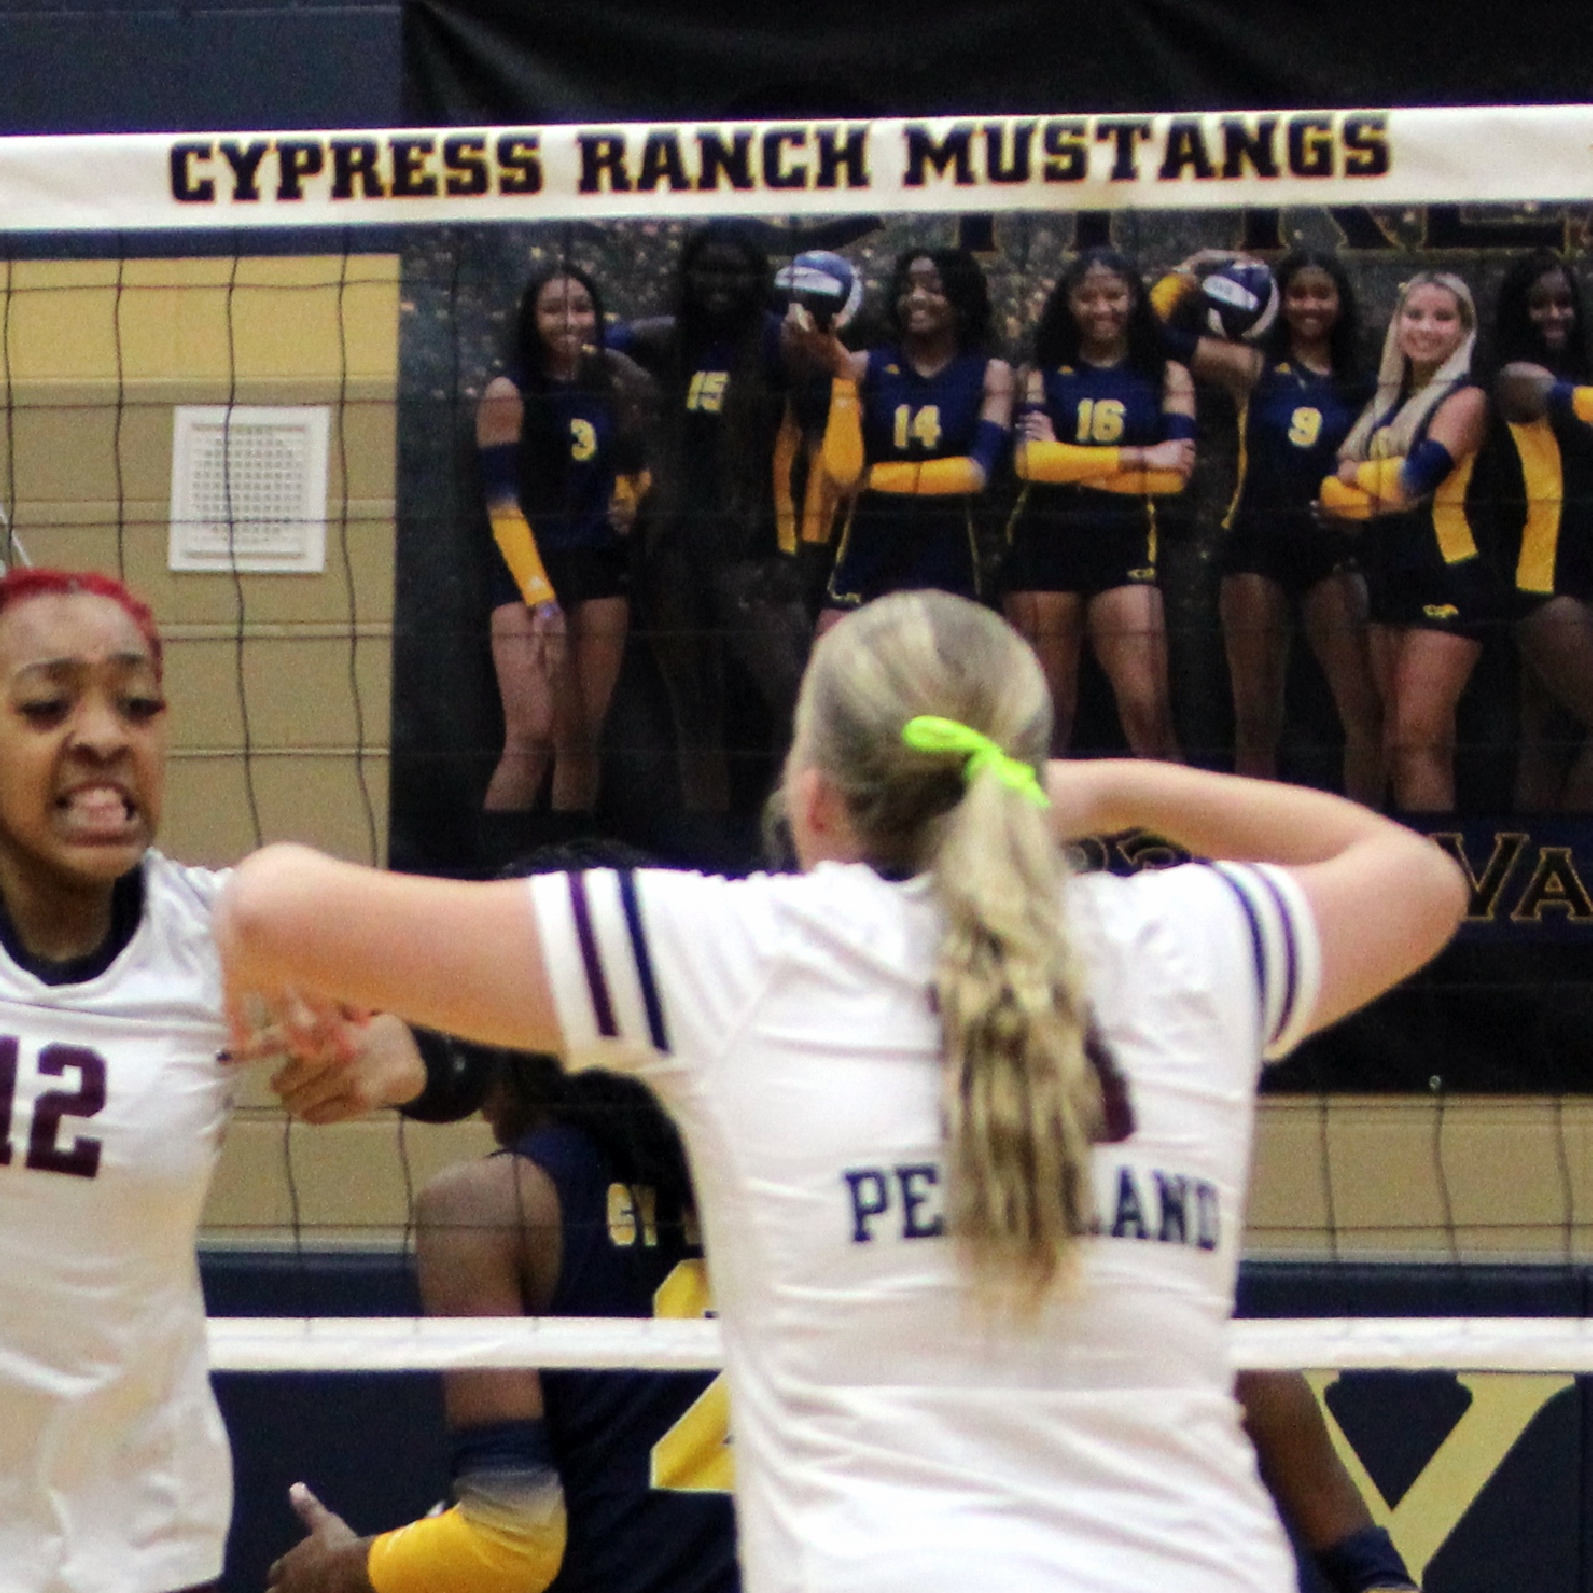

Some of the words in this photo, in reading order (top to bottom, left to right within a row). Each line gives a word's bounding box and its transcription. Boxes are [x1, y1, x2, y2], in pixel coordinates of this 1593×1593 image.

[168, 131, 542, 203] CYPRESS
[578, 122, 872, 194] RANCH
[903, 111, 1392, 187] MUSTANGS
[686, 370, 730, 412] 15
[570, 417, 598, 462] 3
[893, 403, 942, 449] 14
[1075, 399, 1127, 443] 16
[1287, 406, 1323, 448] 9
[842, 1160, 1221, 1252] PEAND
